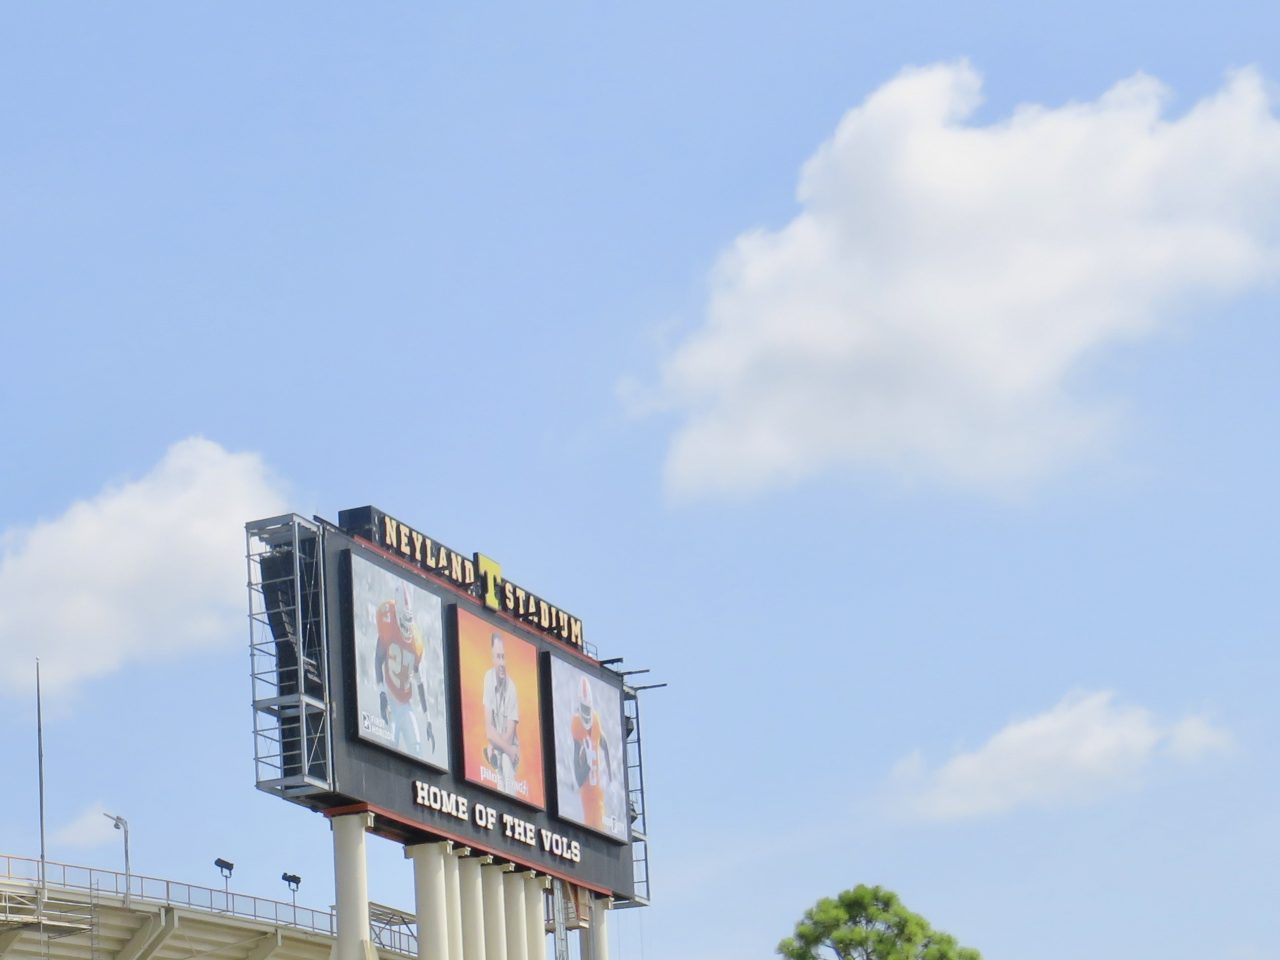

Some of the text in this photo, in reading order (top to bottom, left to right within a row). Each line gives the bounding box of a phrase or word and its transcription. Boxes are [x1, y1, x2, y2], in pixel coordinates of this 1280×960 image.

[384, 516, 582, 646] NEYLAND T STADIUM
[416, 780, 469, 821] HOME
[475, 803, 497, 830] OF
[503, 813, 536, 846] THE
[540, 828, 581, 863] VOLS
